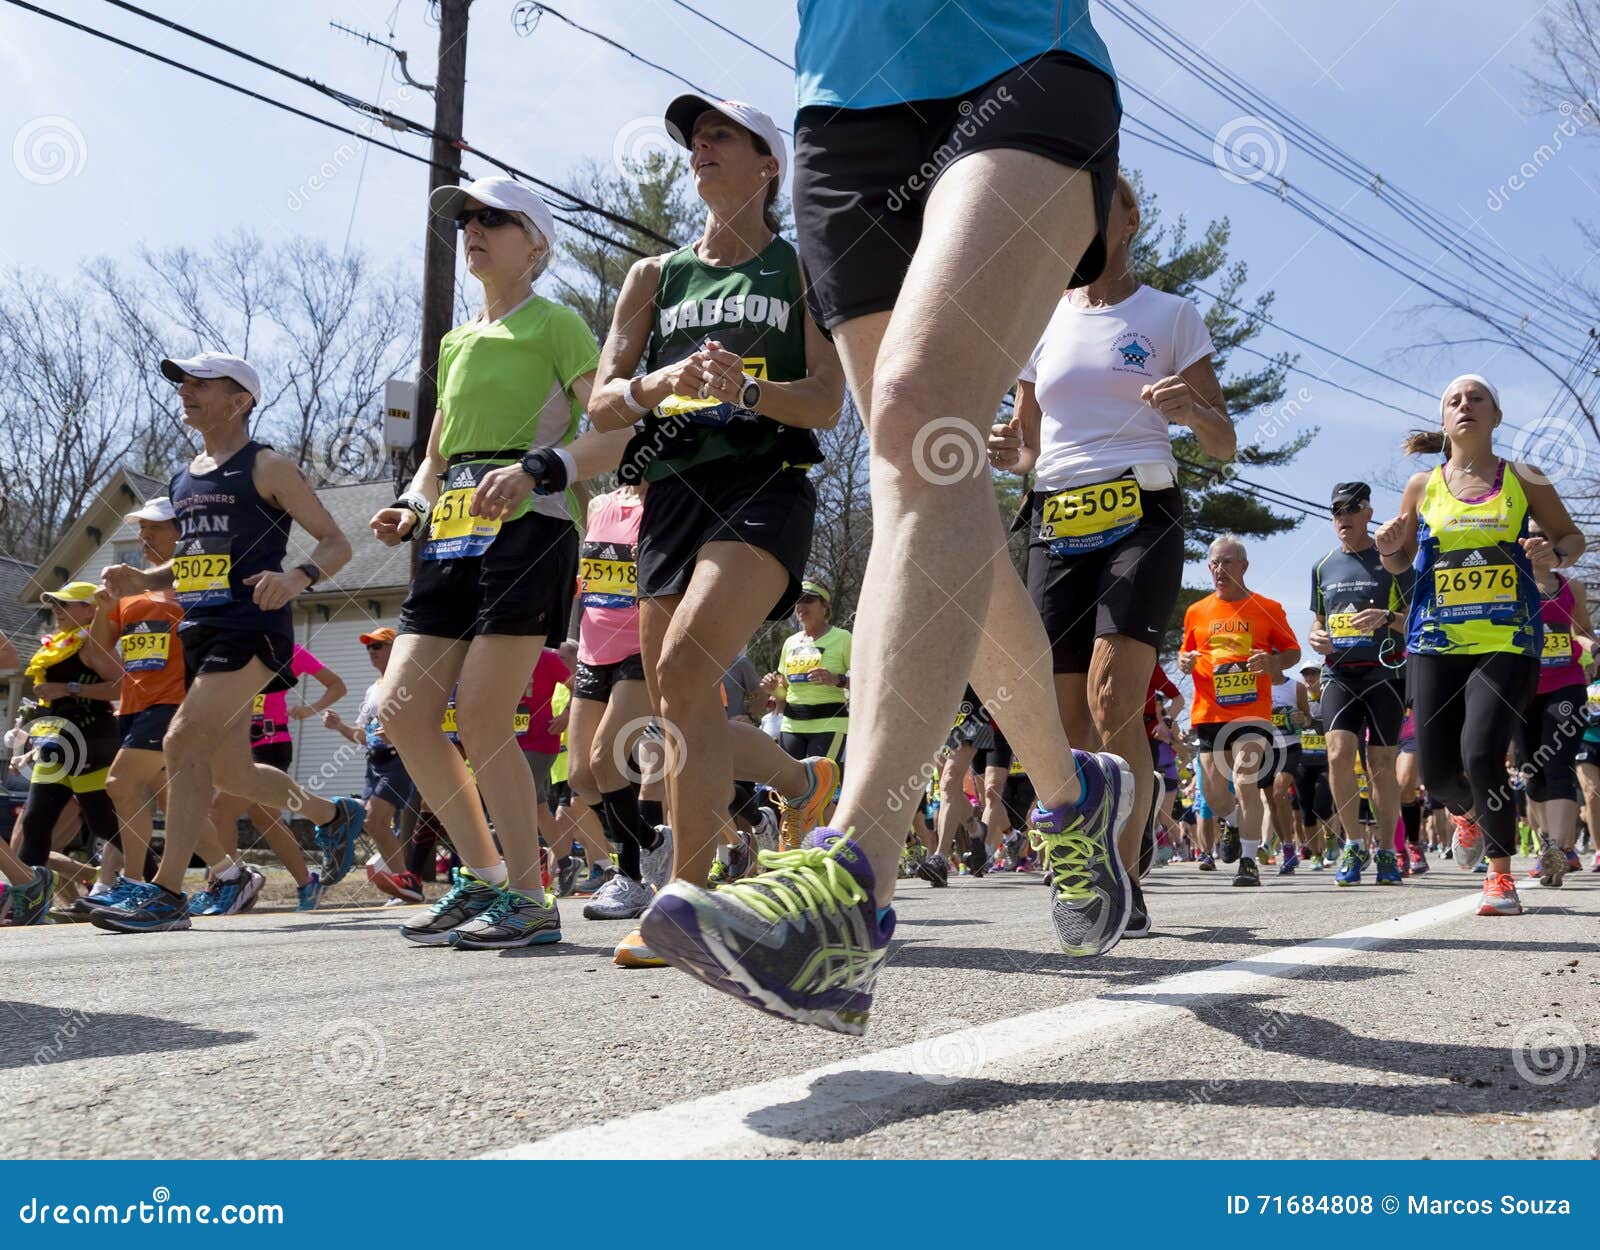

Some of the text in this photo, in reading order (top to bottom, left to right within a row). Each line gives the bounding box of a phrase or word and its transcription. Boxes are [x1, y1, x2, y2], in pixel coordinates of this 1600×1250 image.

[1047, 485, 1137, 523] 25505
[1046, 525, 1056, 538] 2
[173, 559, 228, 580] 25022
[1462, 559, 1488, 567] adidas
[583, 562, 637, 584] 25118
[1438, 569, 1514, 593] 26976
[1213, 621, 1249, 633] RUN
[123, 635, 166, 653] 25931
[1544, 635, 1570, 649] 233
[1215, 674, 1256, 689] 25269
